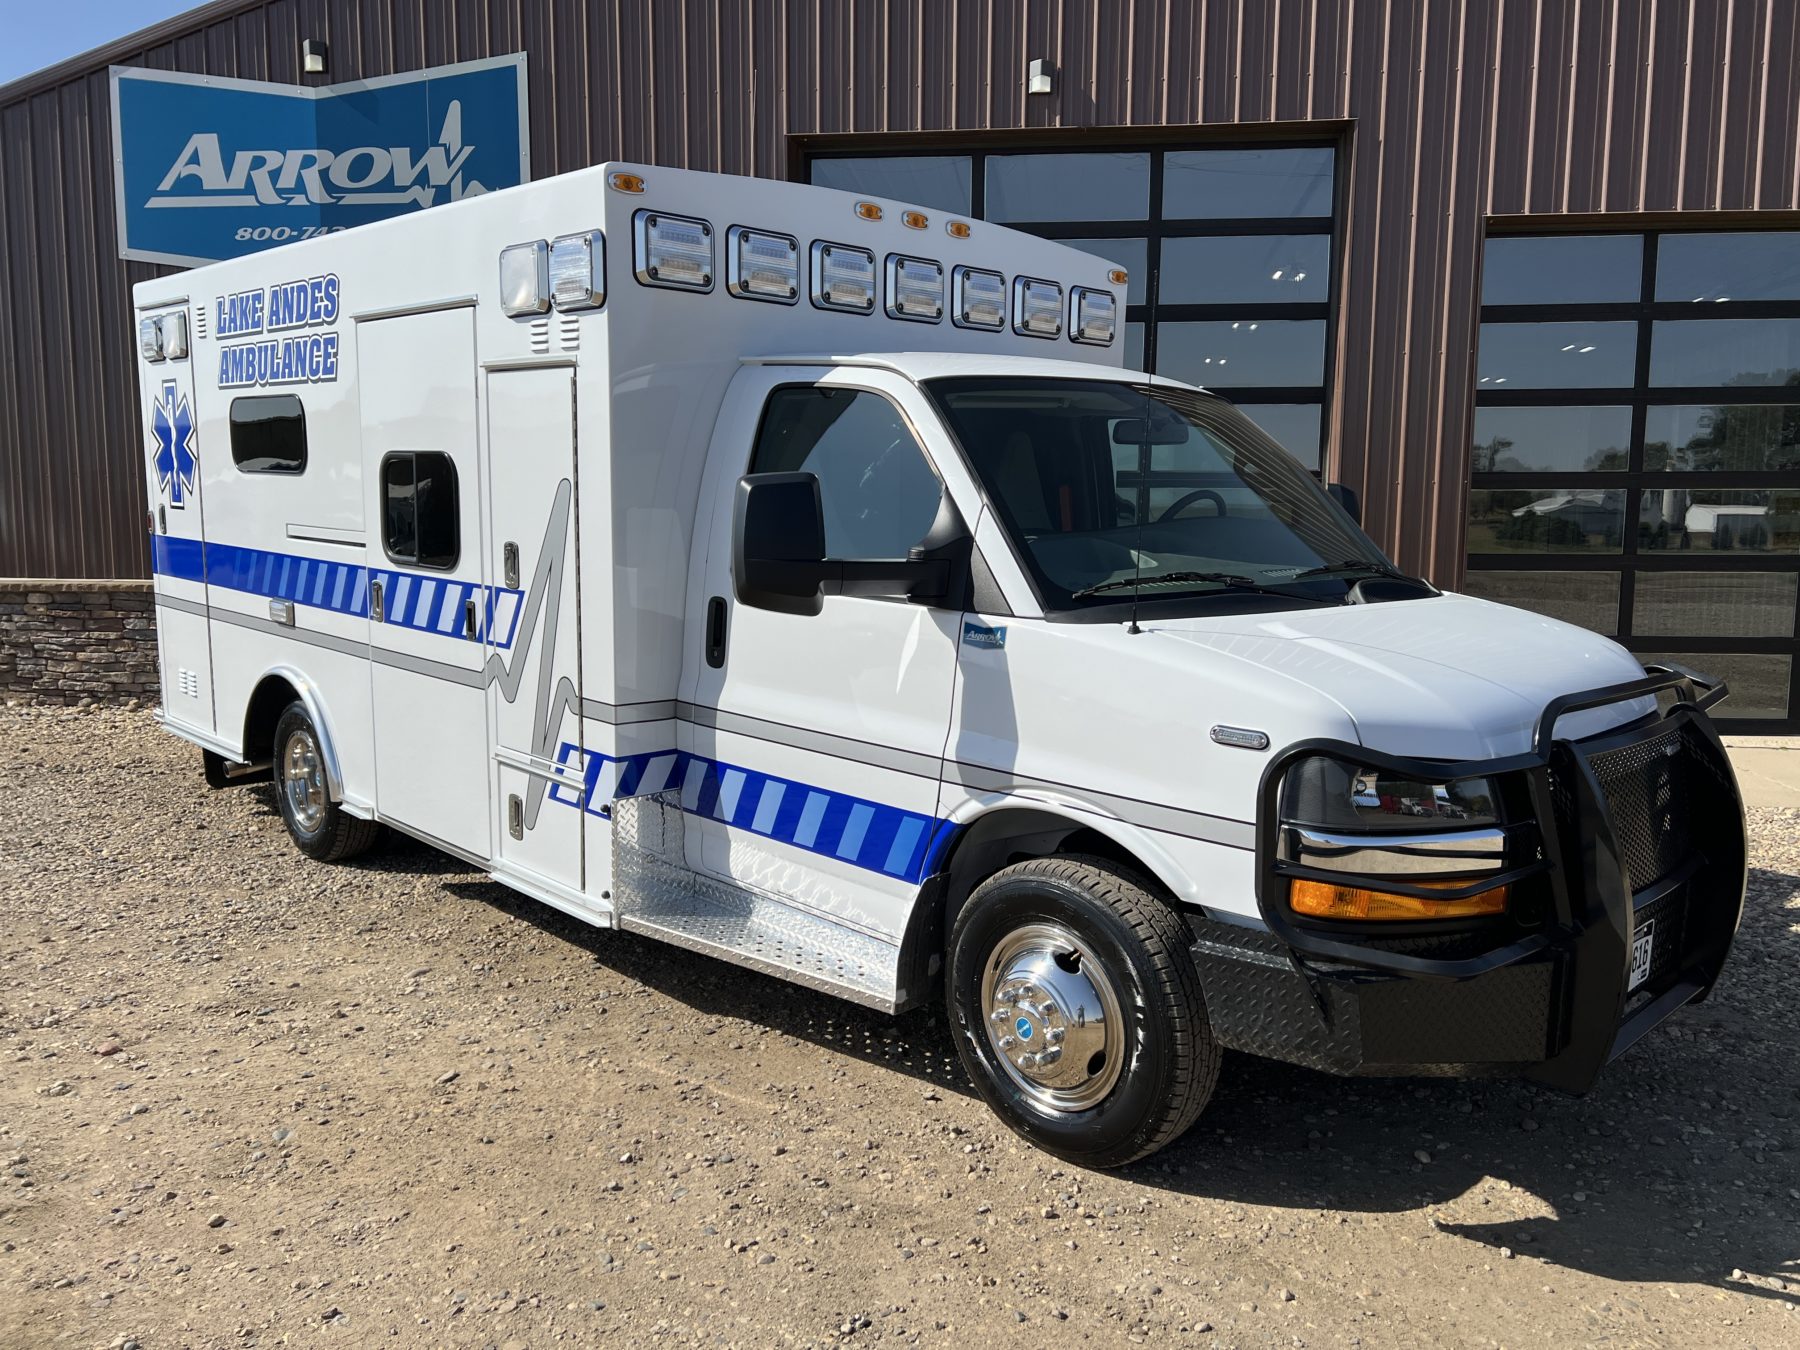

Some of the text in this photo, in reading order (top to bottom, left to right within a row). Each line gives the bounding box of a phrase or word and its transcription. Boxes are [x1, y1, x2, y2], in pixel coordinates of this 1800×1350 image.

[156, 133, 475, 205] ARROW
[216, 273, 340, 340] LAKE ANDES
[218, 332, 339, 390] AMBULANCE
